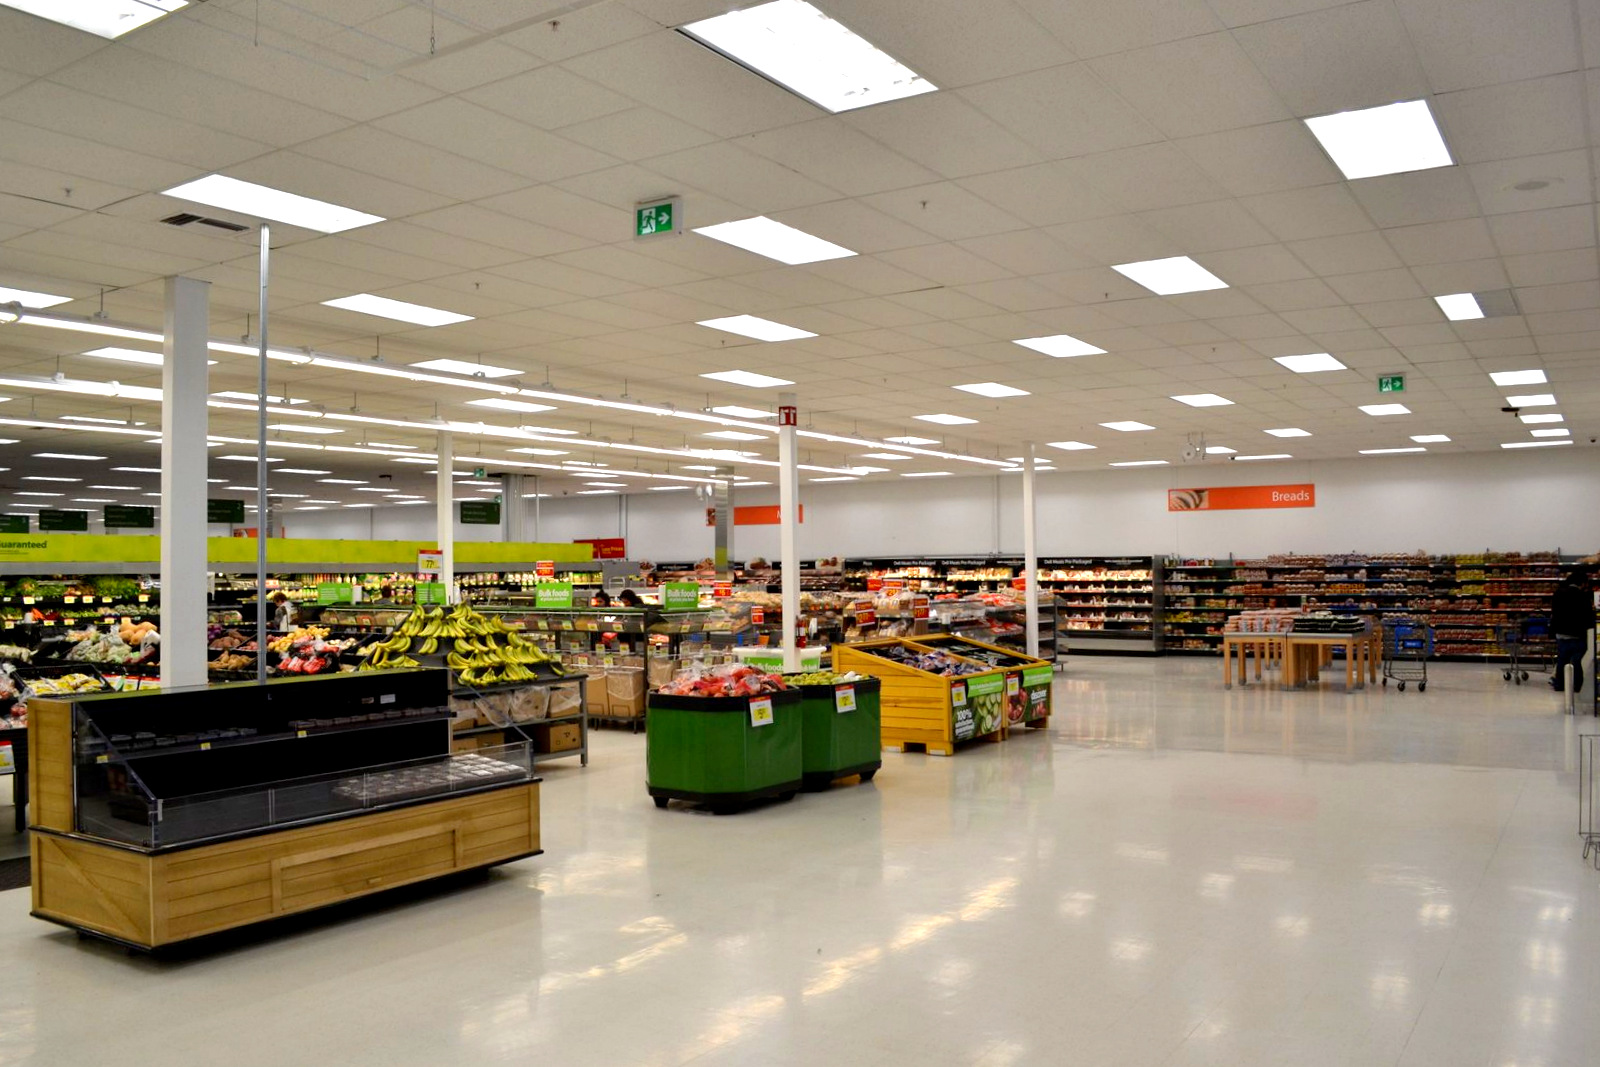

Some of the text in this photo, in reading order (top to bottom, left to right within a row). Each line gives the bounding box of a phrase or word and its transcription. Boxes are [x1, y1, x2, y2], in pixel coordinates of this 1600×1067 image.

[1272, 490, 1310, 502] Breads
[538, 589, 570, 597] Bulk foods
[680, 589, 697, 598] foods
[957, 708, 973, 721] 100%
